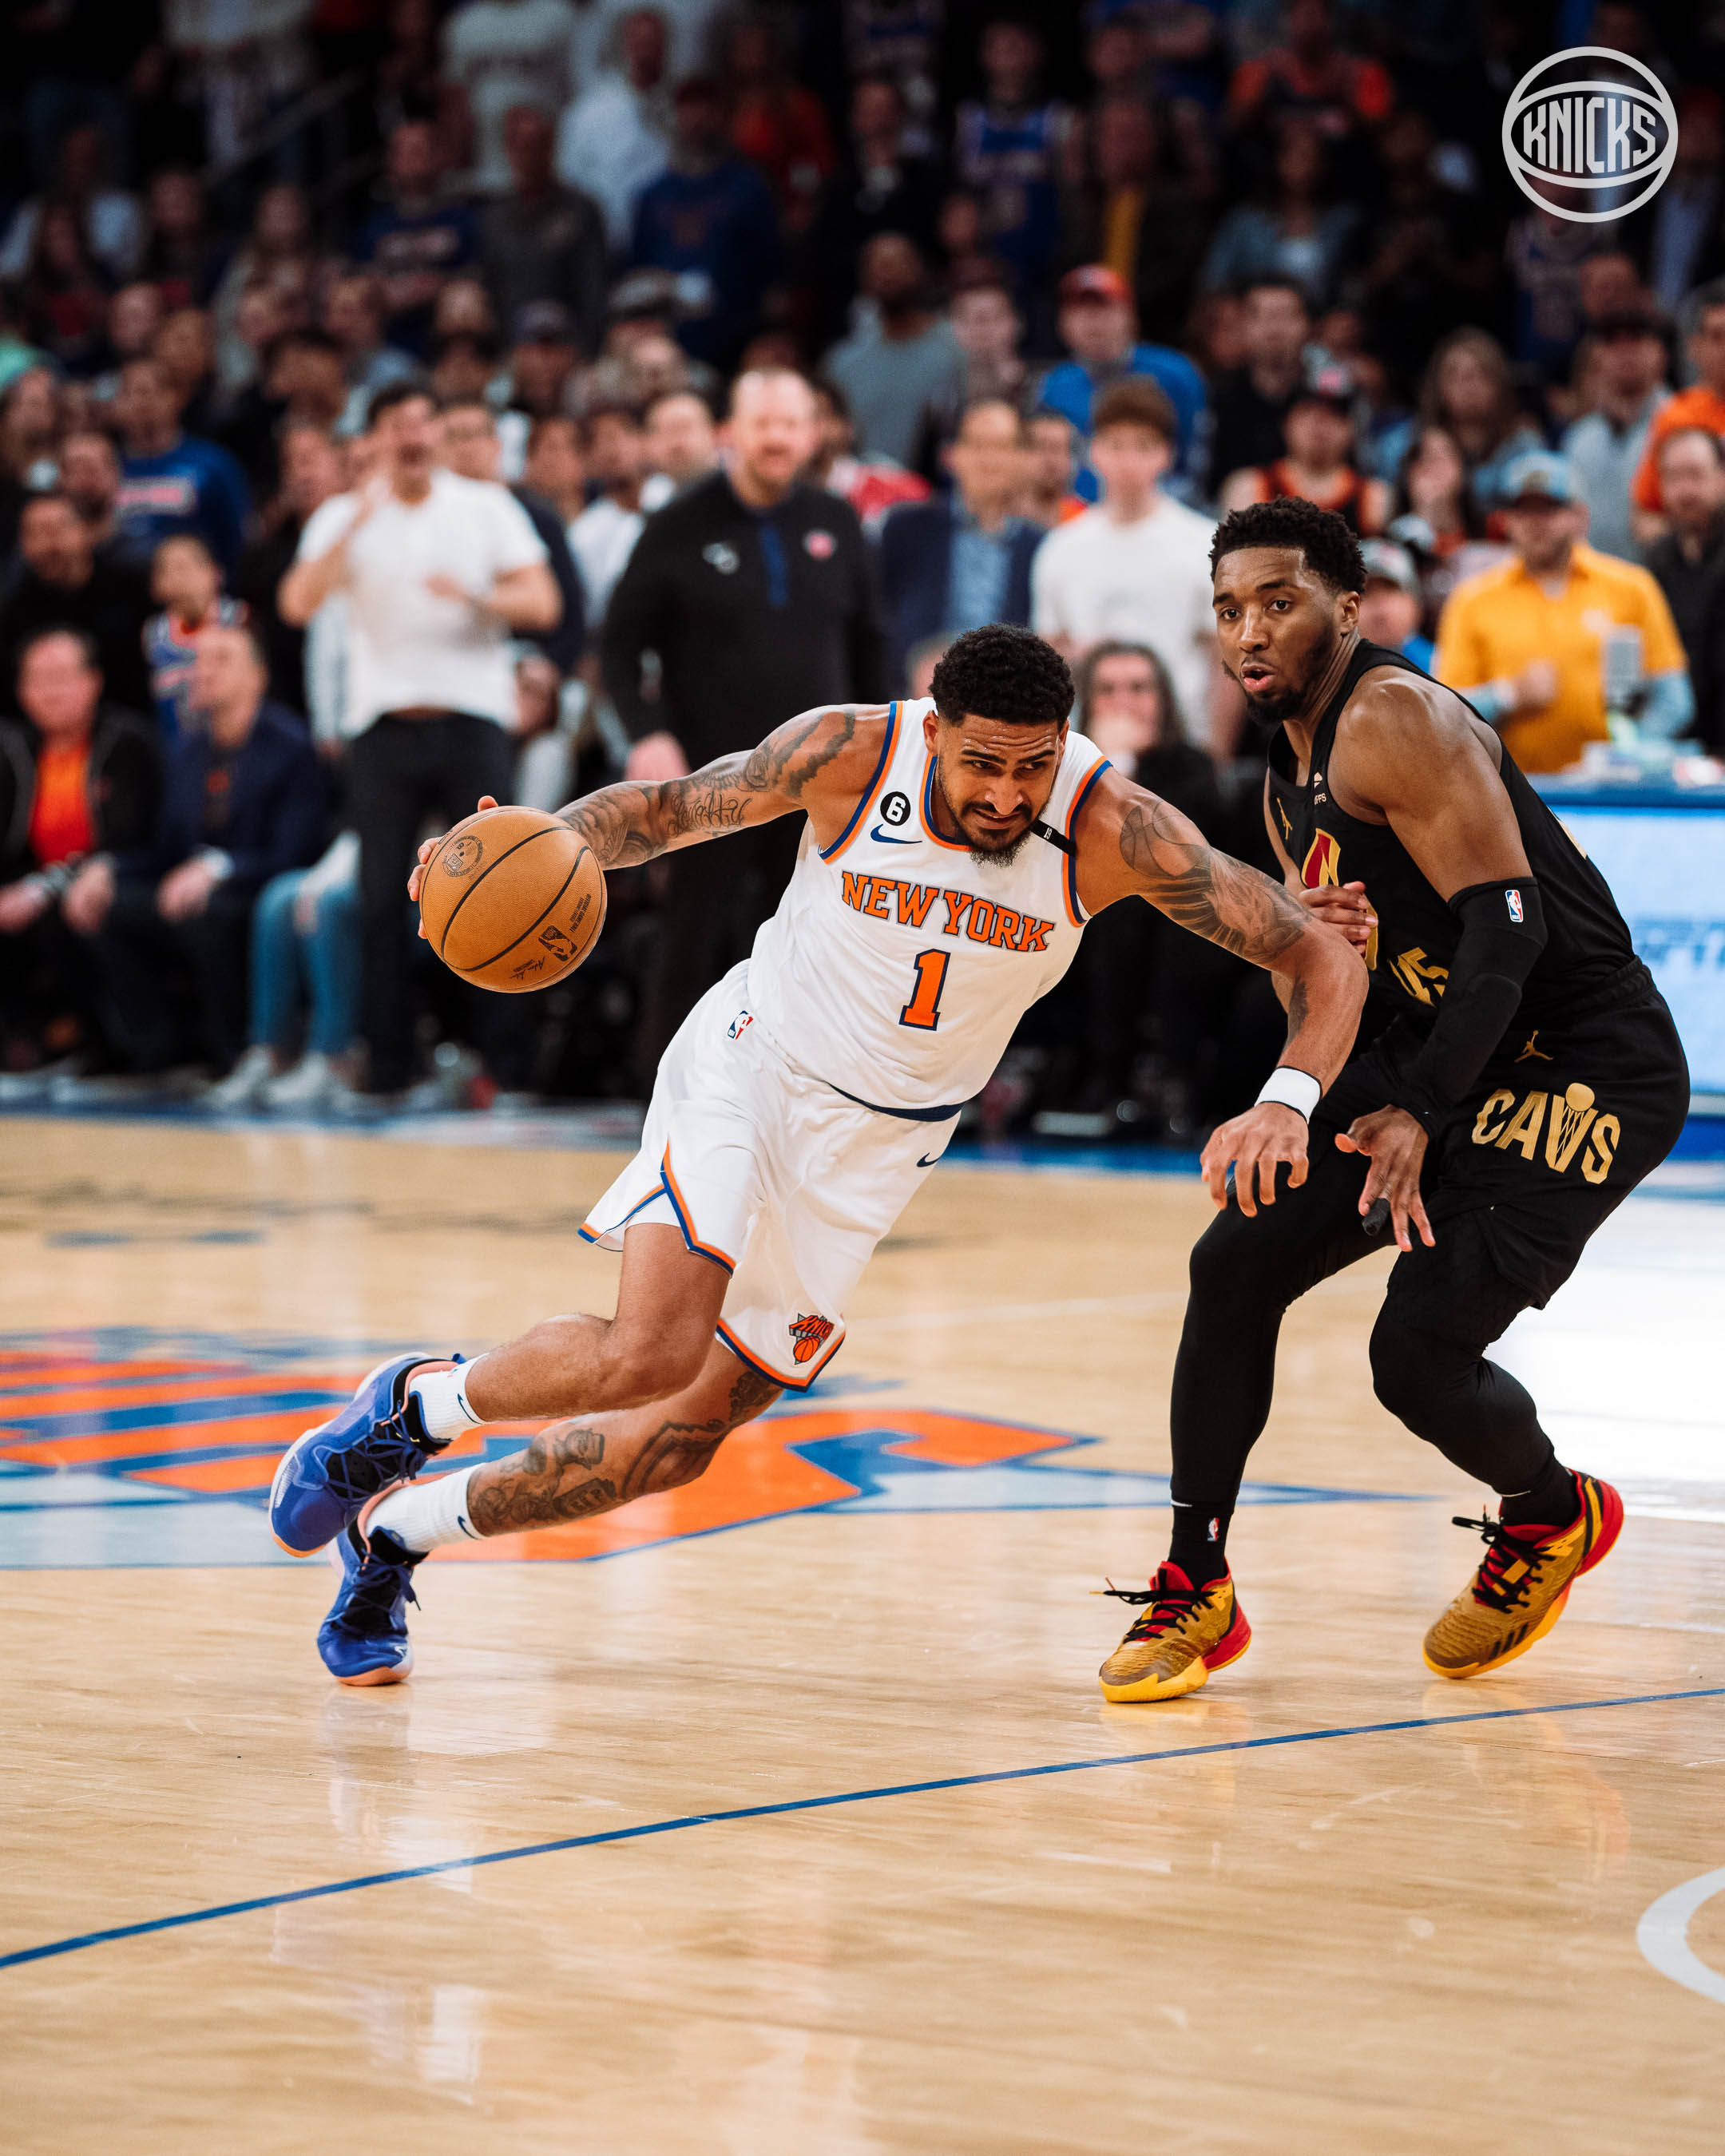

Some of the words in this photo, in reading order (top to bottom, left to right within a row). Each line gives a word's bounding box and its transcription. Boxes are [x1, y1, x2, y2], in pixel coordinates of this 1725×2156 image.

[886, 796, 906, 822] 6
[841, 870, 941, 929] NEW
[942, 889, 1057, 952] YORK
[898, 948, 950, 1031] 1
[1471, 1083, 1620, 1185] CAVS
